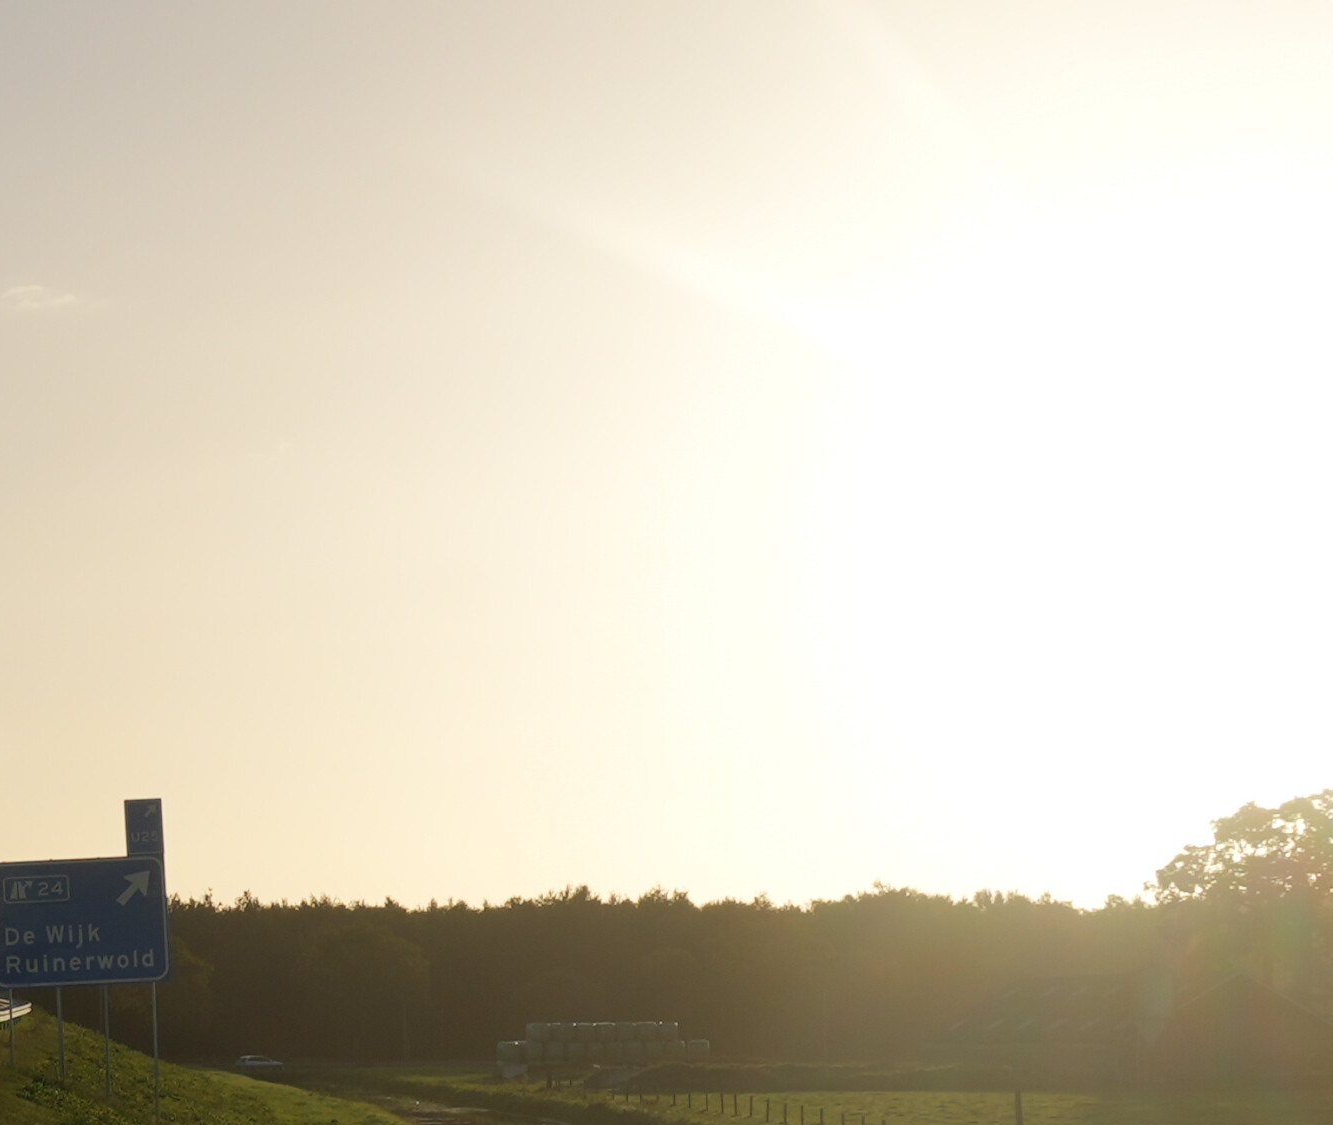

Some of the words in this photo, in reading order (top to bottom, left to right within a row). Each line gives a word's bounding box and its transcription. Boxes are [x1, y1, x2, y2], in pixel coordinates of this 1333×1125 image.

[37, 881, 64, 896] 24
[4, 927, 36, 946] De
[46, 923, 101, 948] Wijk
[5, 949, 155, 974] Ruinerwold
